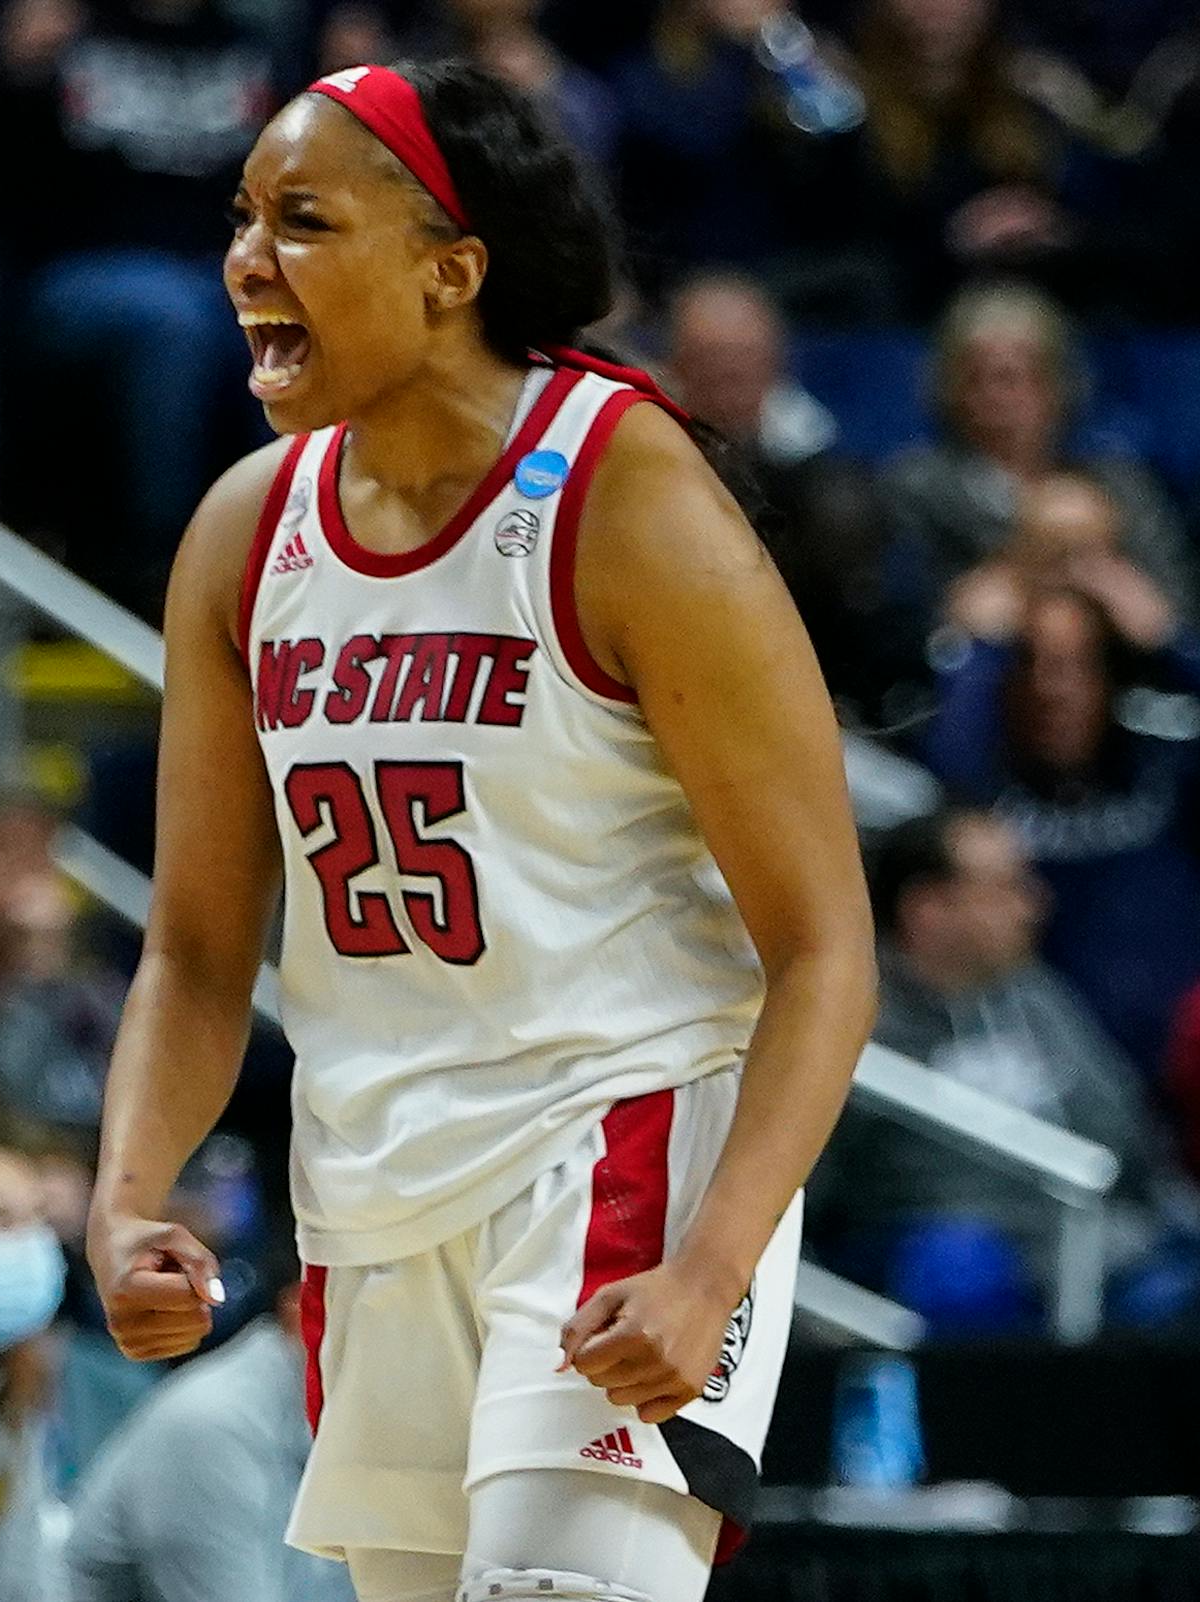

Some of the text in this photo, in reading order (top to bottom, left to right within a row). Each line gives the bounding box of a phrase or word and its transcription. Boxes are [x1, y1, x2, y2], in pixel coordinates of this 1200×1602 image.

[256, 631, 539, 733] NC STATE
[284, 760, 487, 966] 25
[579, 1444, 643, 1470] adidas
